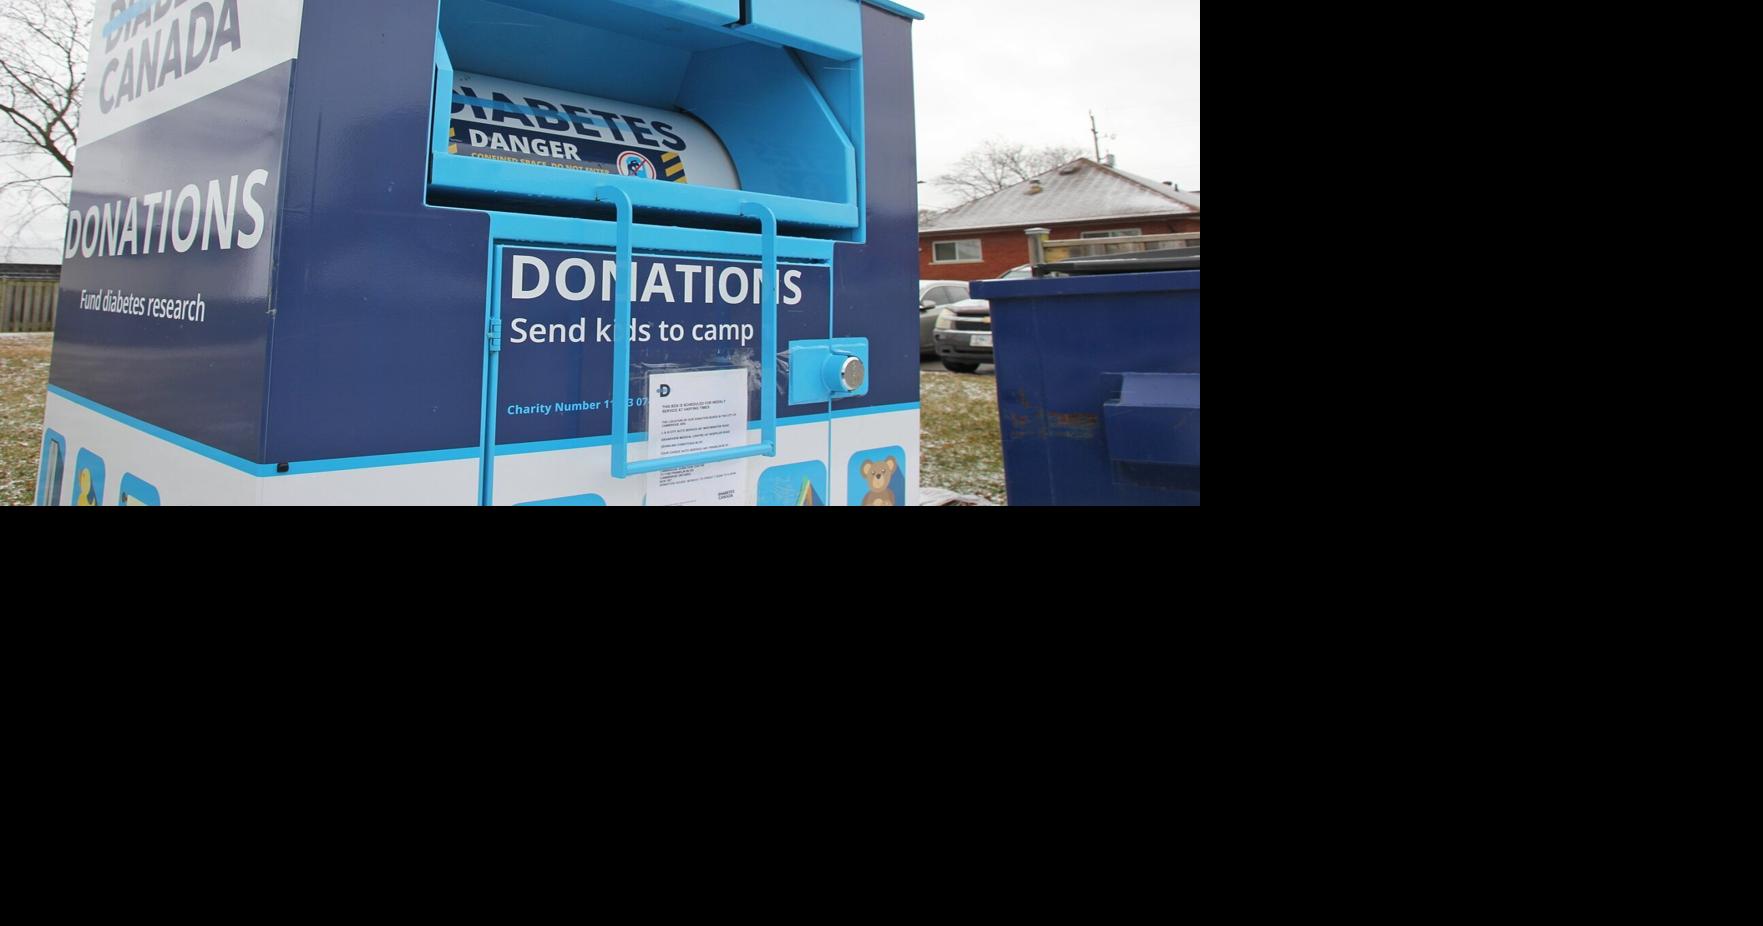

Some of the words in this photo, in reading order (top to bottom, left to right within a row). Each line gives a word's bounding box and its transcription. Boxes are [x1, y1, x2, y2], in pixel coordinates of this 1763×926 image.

[99, 0, 241, 114] CANADA
[468, 129, 582, 161] DANGER
[64, 168, 269, 259] DONATIONS
[80, 289, 103, 311] Fund
[102, 290, 145, 316] diabetes
[147, 293, 205, 322] research
[510, 317, 586, 343] Send
[596, 317, 651, 342] kds
[658, 320, 684, 342] to
[691, 322, 754, 347] camp
[507, 403, 552, 415] Charity
[555, 400, 601, 412] Number
